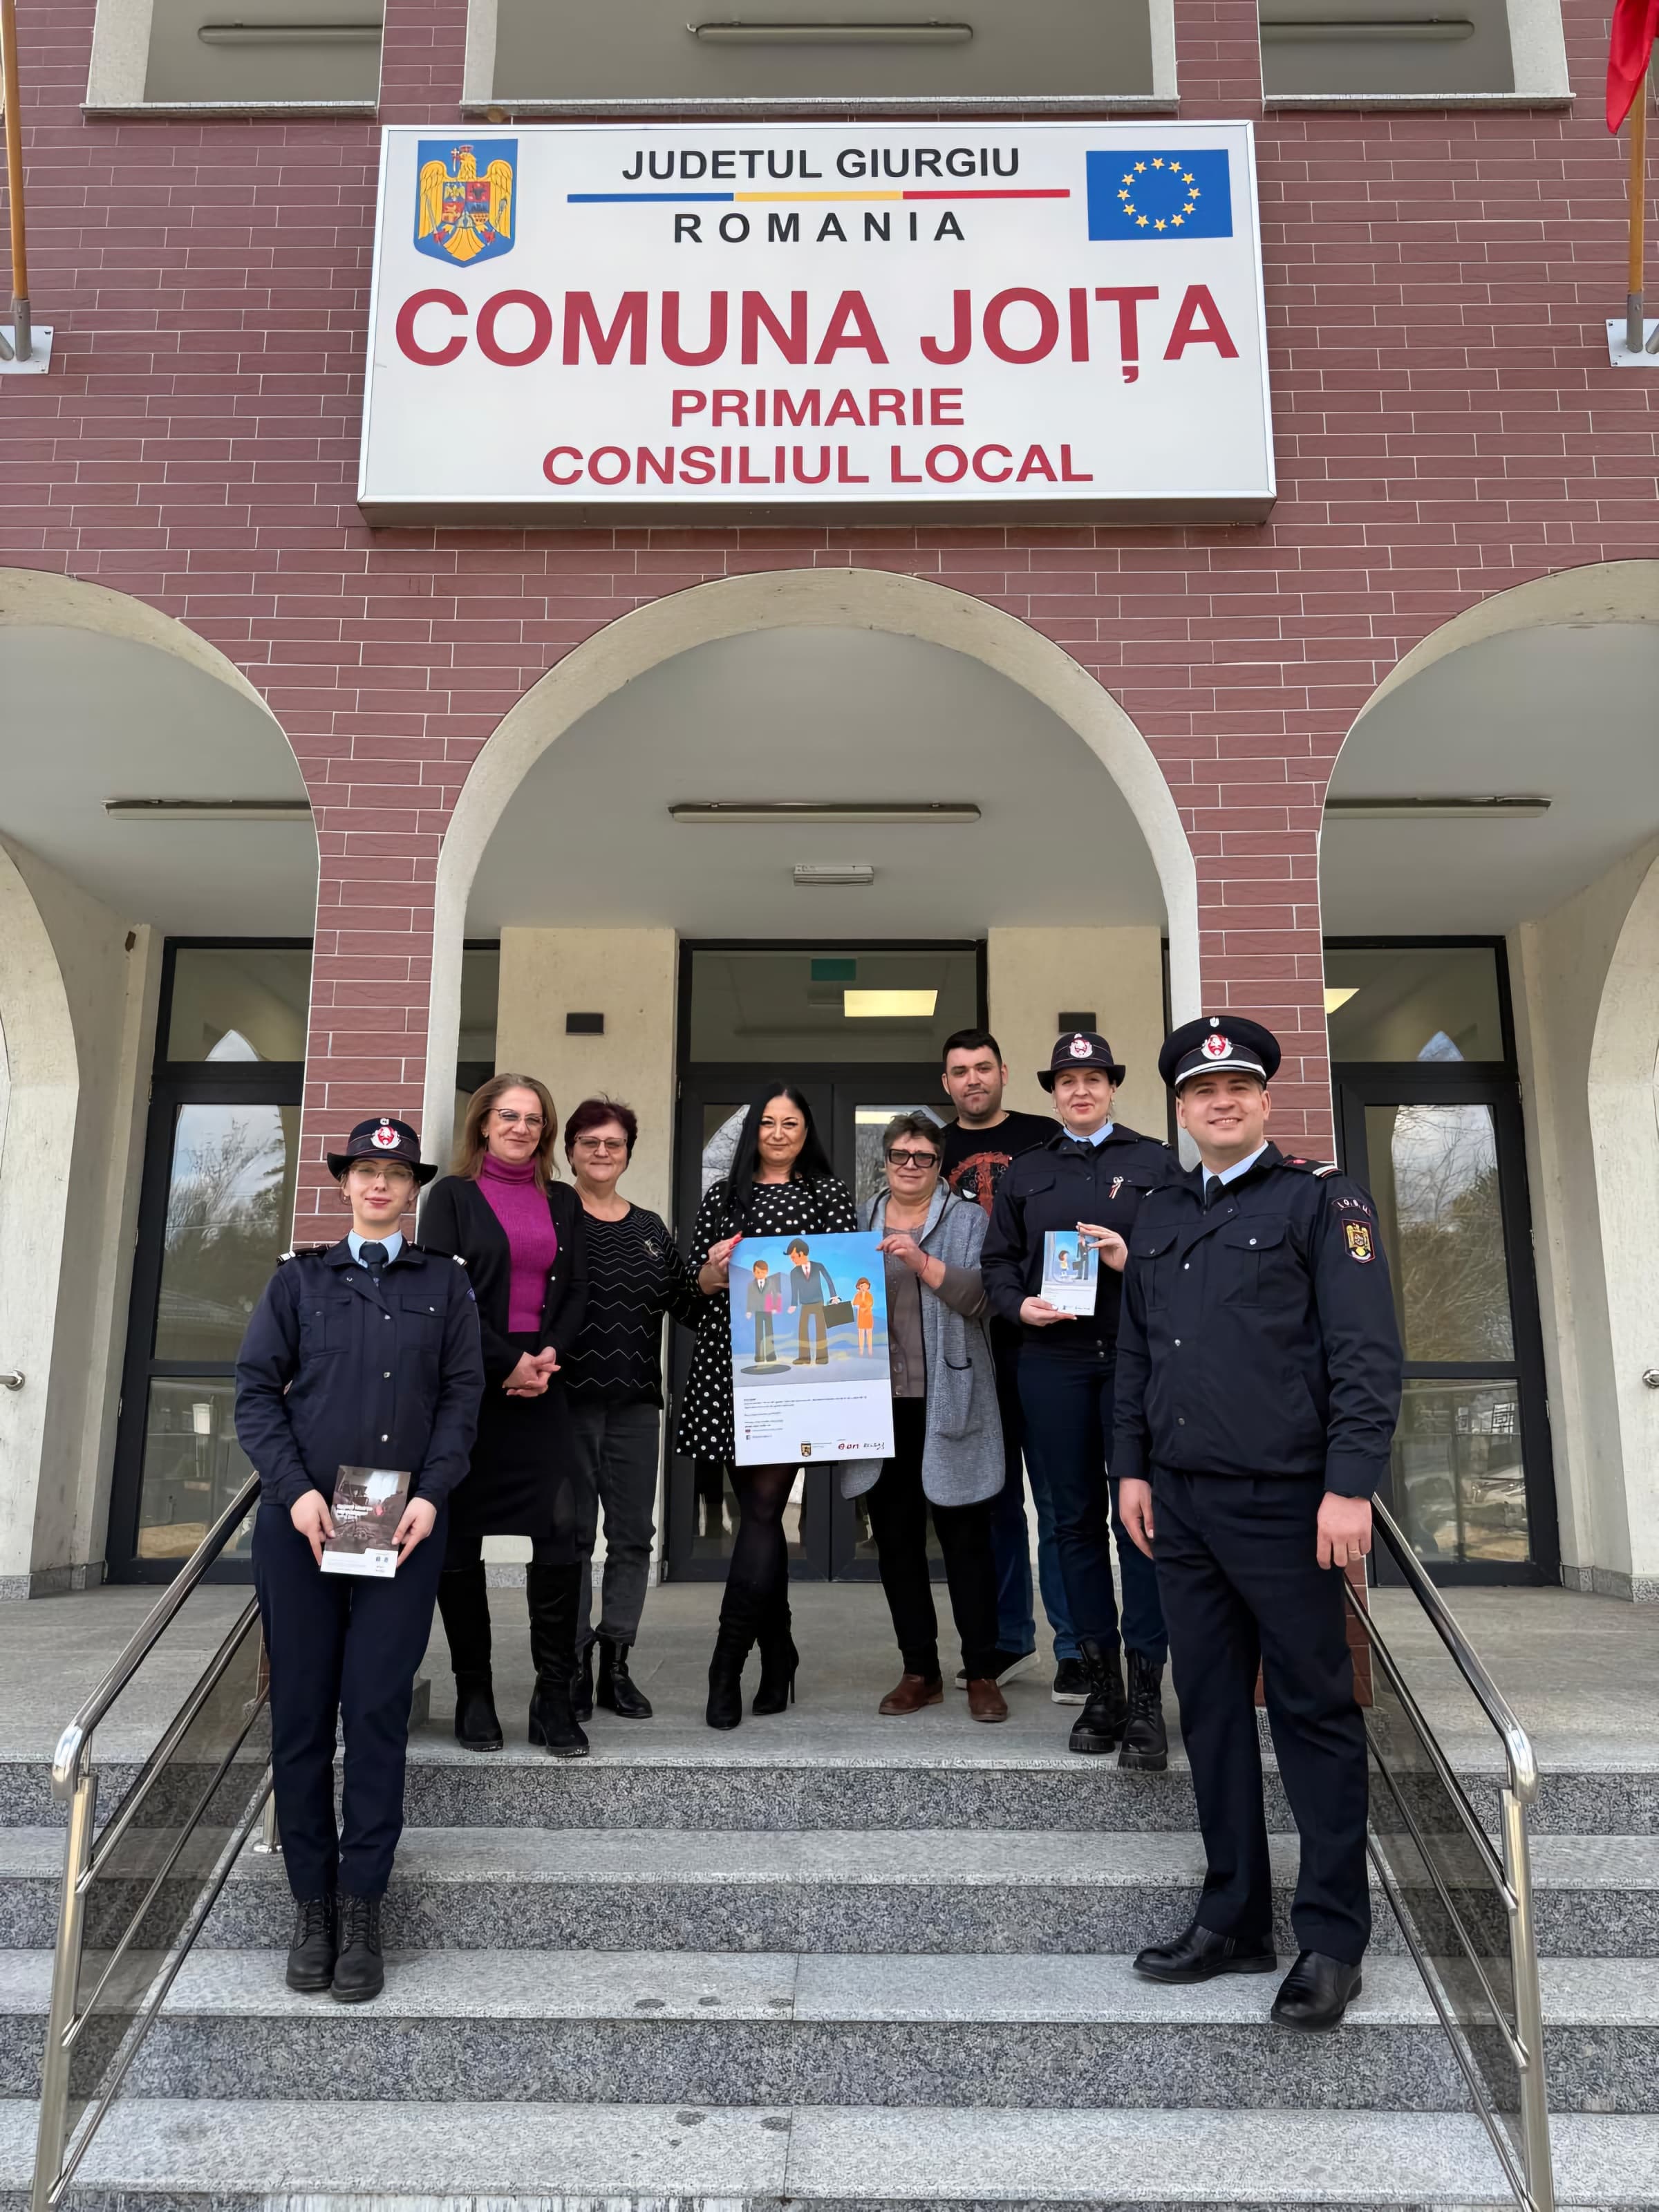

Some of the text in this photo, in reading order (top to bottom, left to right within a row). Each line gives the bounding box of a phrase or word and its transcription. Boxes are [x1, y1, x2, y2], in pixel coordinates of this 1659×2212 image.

[622, 147, 1019, 181] JUDETUL GIURGIU
[673, 210, 966, 243] ROMANIA
[395, 288, 890, 367] COMUNA
[672, 388, 965, 427] PRIMARIE
[543, 443, 1094, 485] CONSILIUL LOCAL
